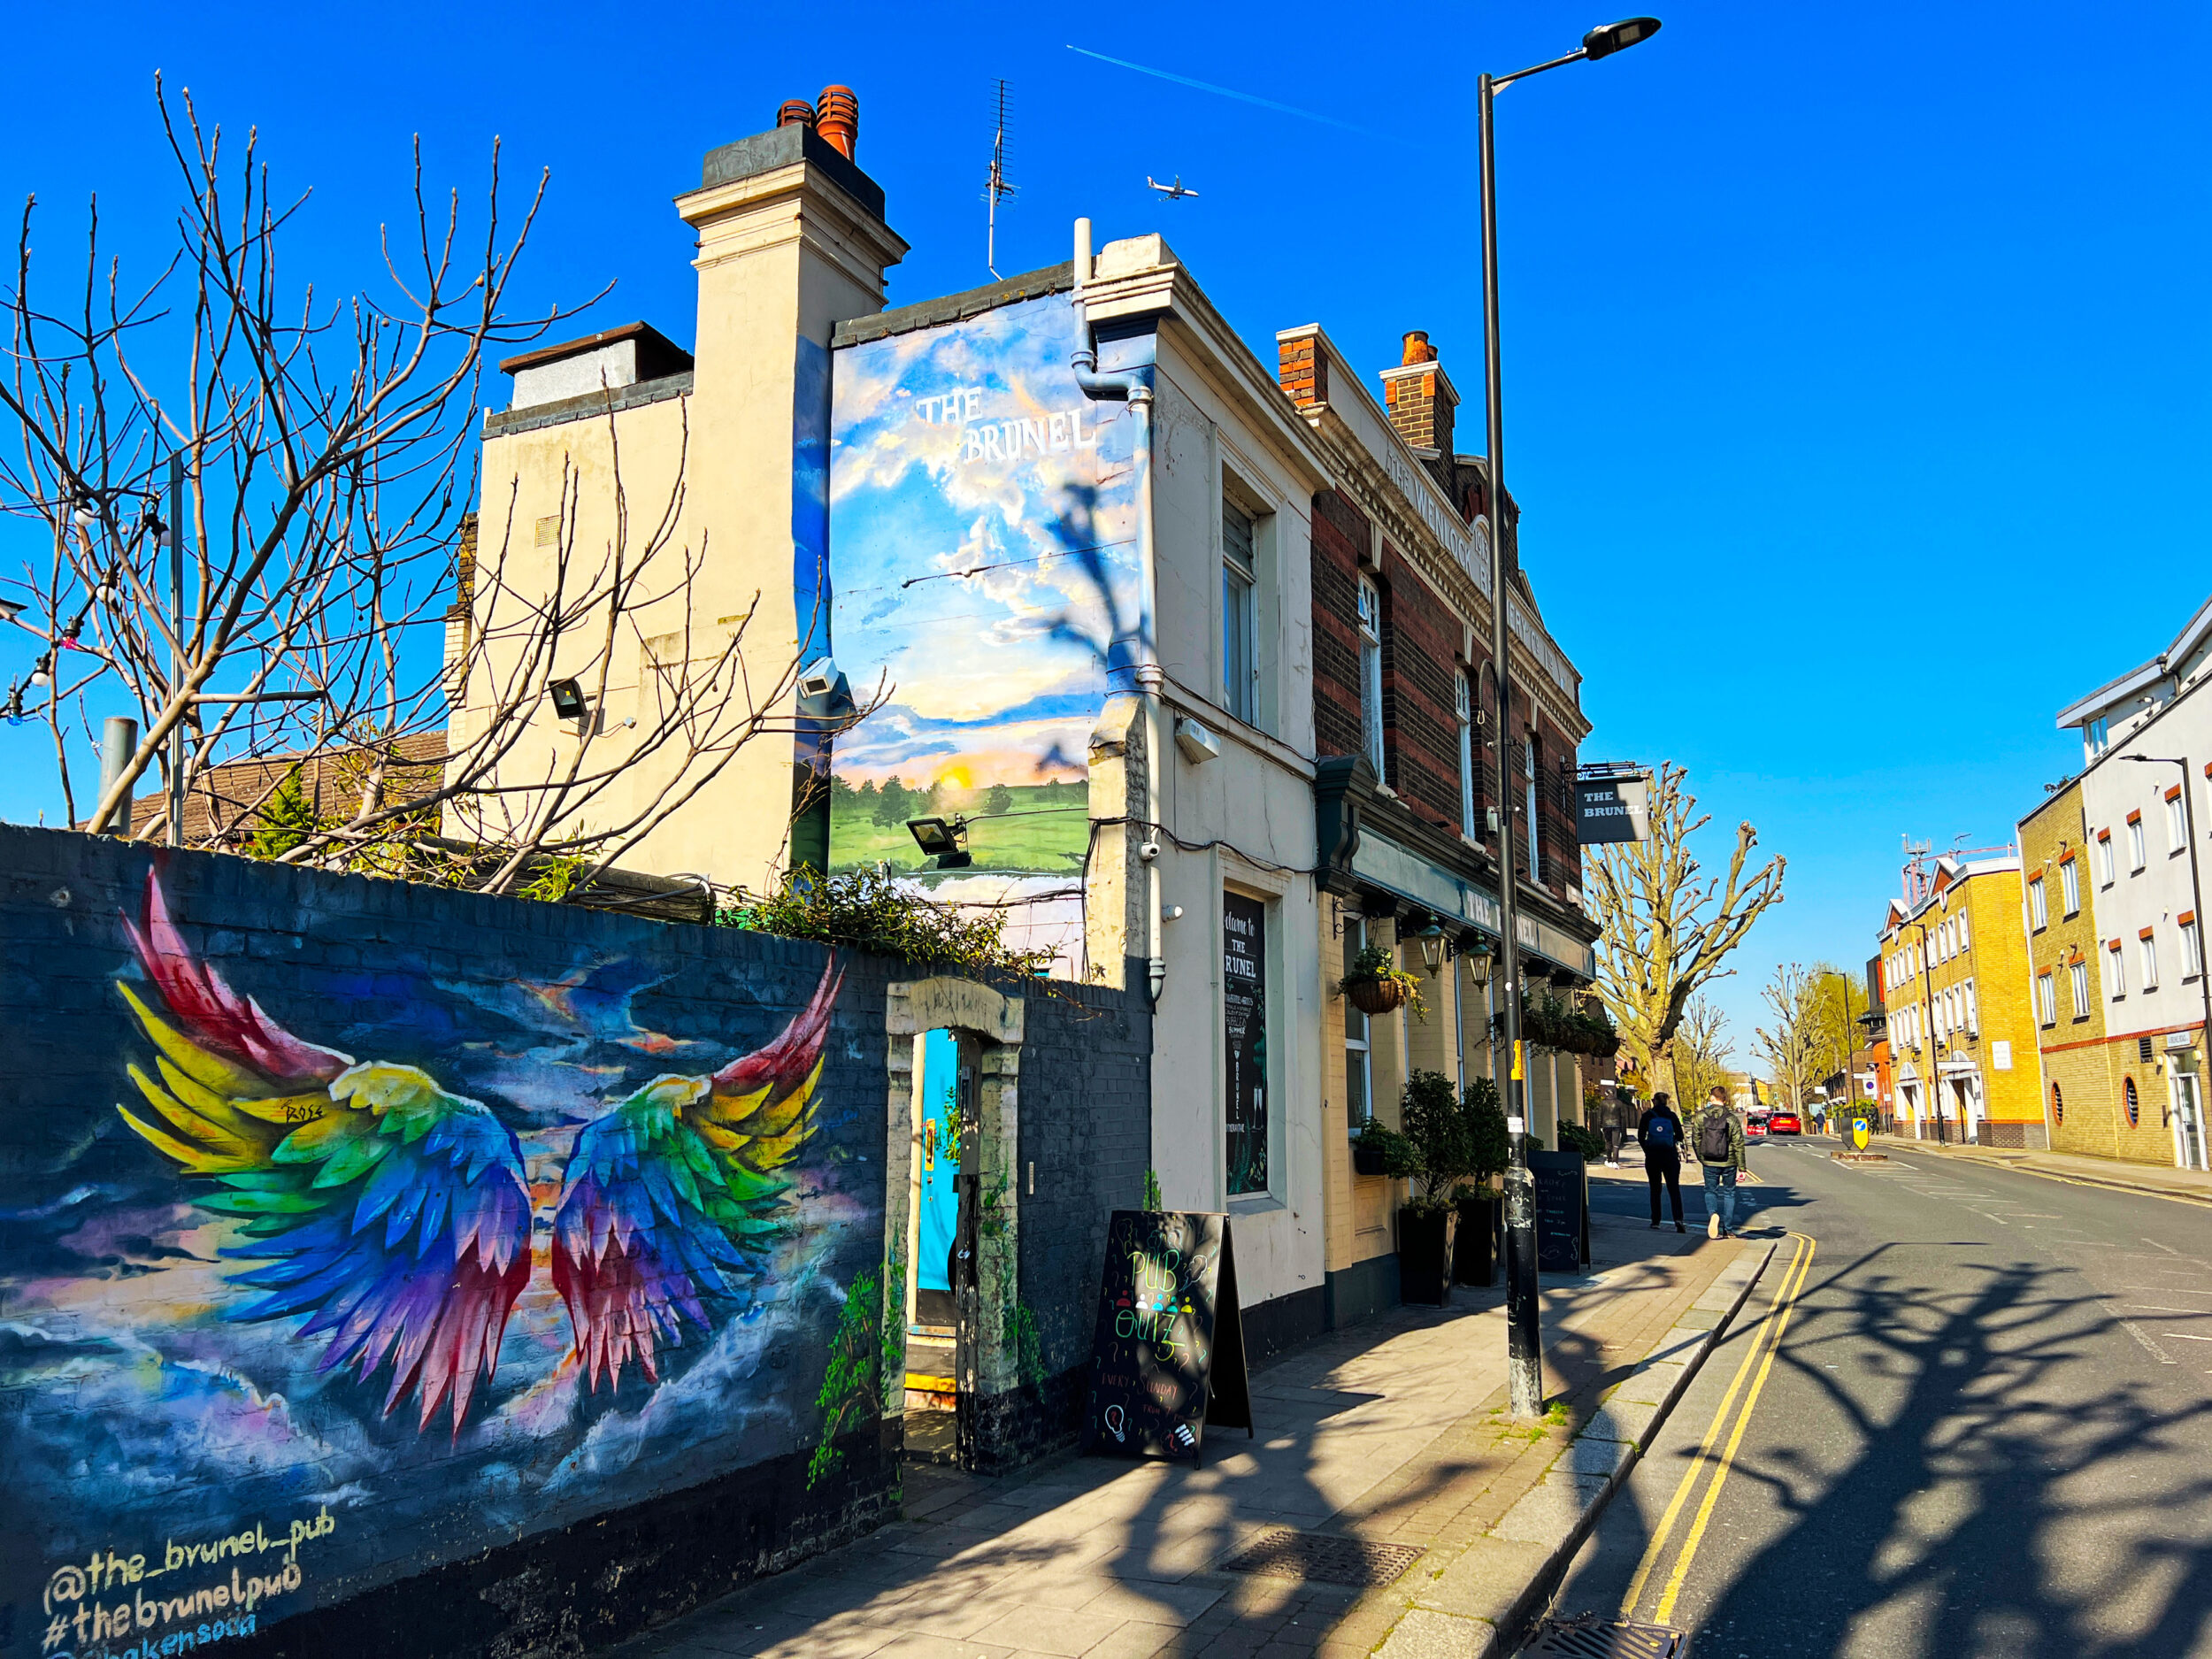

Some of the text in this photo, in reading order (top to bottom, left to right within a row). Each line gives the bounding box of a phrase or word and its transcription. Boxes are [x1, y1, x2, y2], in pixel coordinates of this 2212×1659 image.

[916, 386, 982, 424] THE
[963, 408, 1097, 464] BRUNEL
[1415, 482, 1472, 580] WENLOCK
[1584, 791, 1614, 803] THE
[1584, 804, 1643, 818] BRUNEL
[1225, 910, 1247, 935] elcome
[1466, 889, 1492, 927] THE
[1231, 939, 1246, 954] THE
[1225, 955, 1256, 979] RUNEL
[1126, 1248, 1180, 1293] PUB
[1115, 1309, 1186, 1348] QUIZ
[1136, 1371, 1179, 1401] SUNDAY
[42, 1504, 335, 1616] @the_brunel_pub
[41, 1555, 302, 1655] #thebrunelpub
